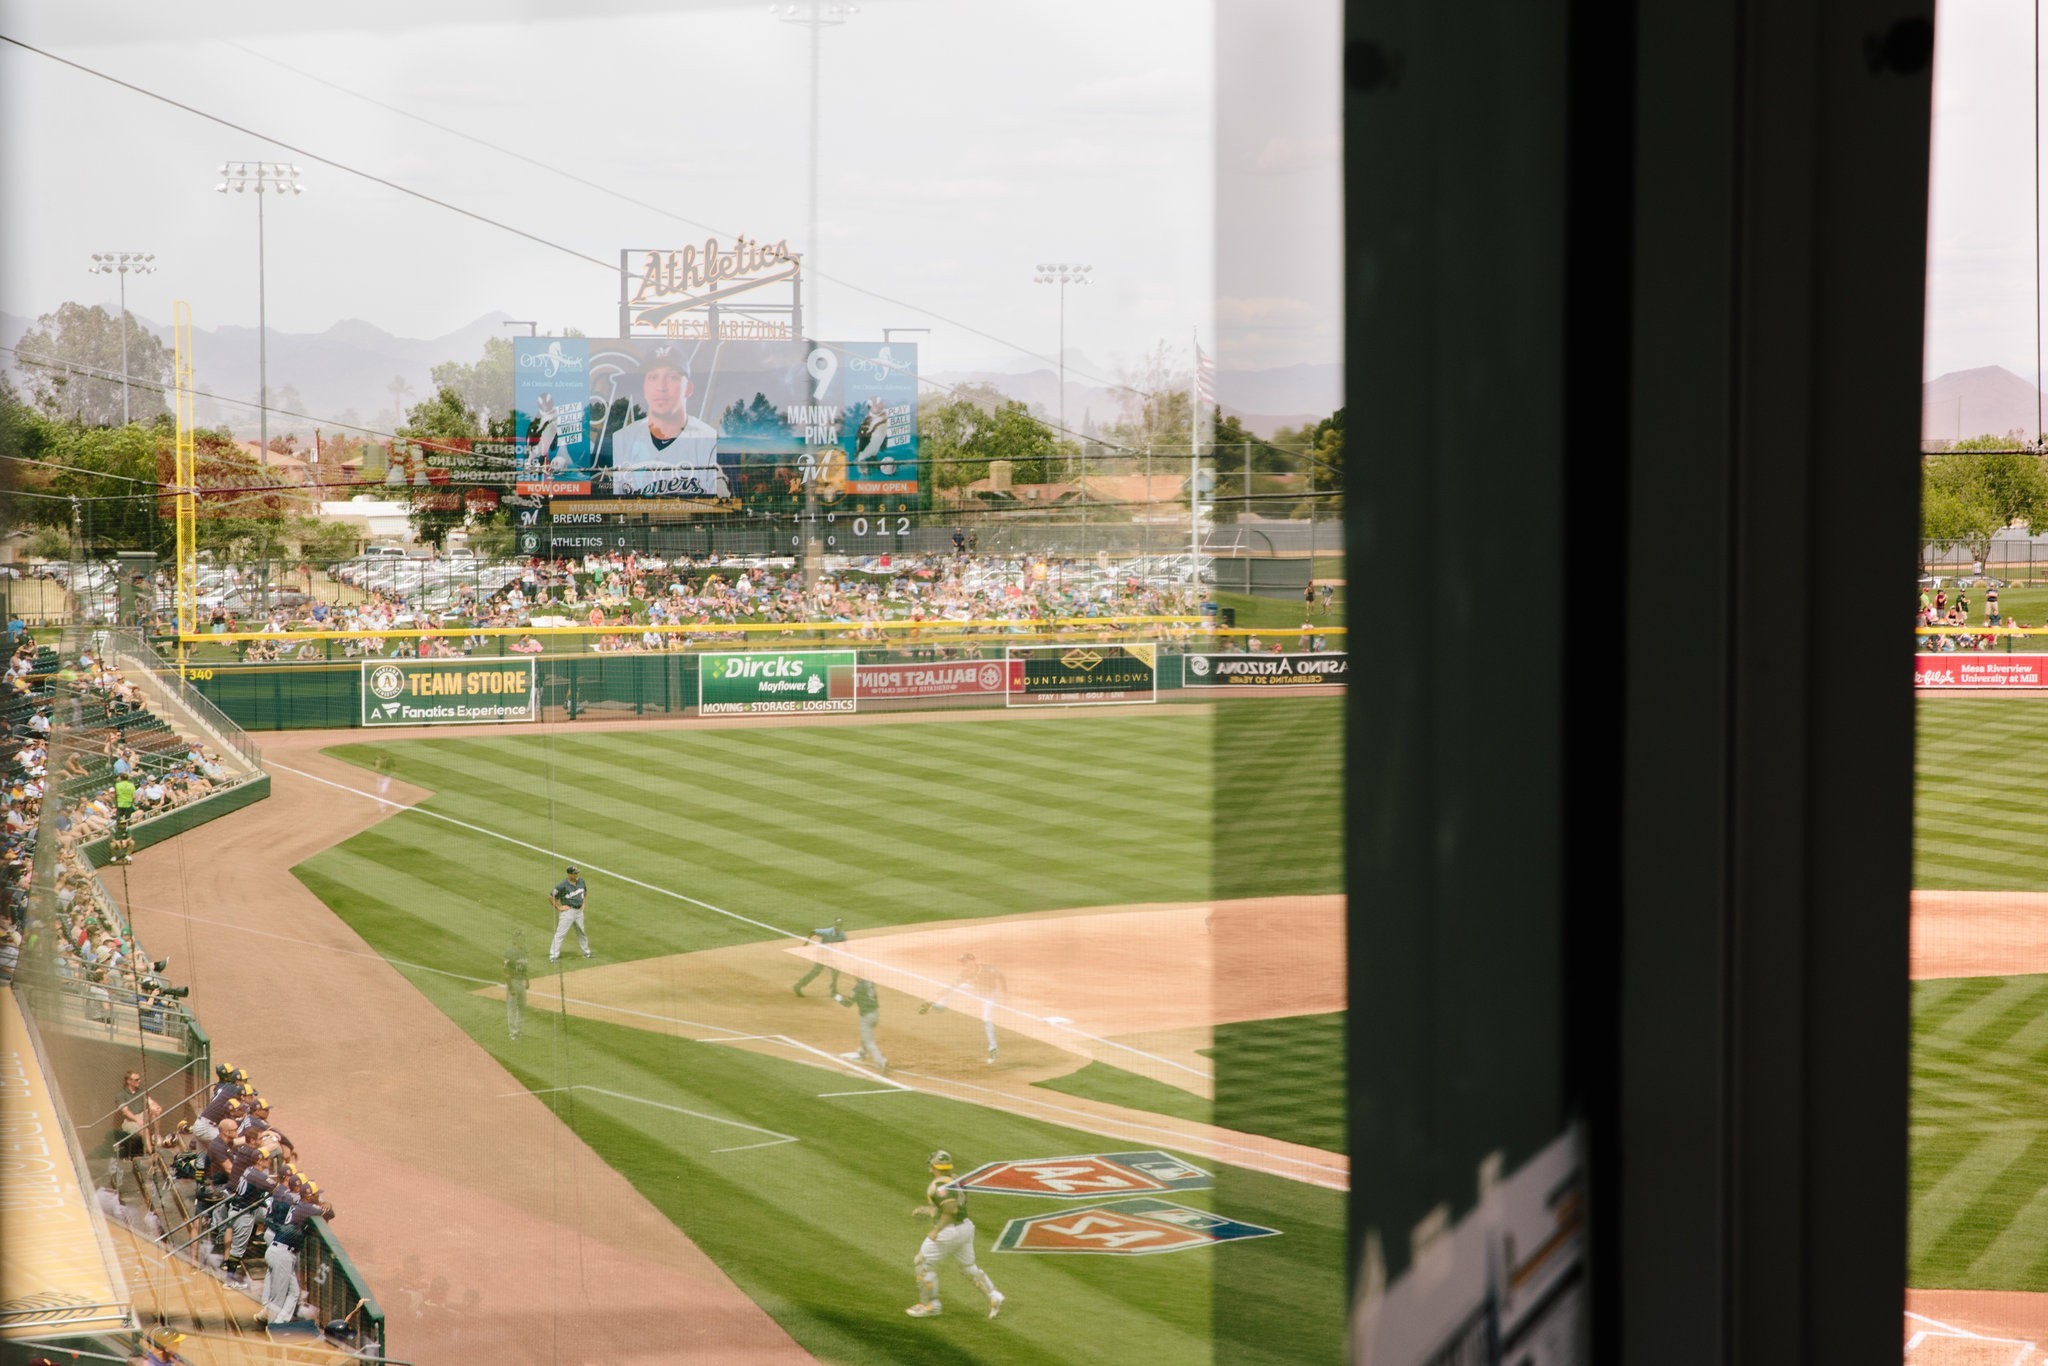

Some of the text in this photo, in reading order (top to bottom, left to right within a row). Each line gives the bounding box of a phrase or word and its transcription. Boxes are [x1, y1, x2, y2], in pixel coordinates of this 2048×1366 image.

[629, 234, 798, 305] Athletics
[667, 319, 787, 340] MESA ARIZONA
[807, 349, 838, 400] 9
[559, 403, 578, 412] PLAY
[888, 406, 908, 415] PLAY
[560, 414, 580, 423] BALL
[788, 405, 838, 424] MANNY
[890, 416, 909, 425] BALL
[561, 424, 581, 433] WITH
[891, 426, 909, 435] WITH
[565, 435, 579, 443] US!
[894, 436, 907, 445] US!
[527, 484, 580, 492] NOW OPEN
[856, 483, 908, 491] NOW OPEN
[553, 514, 835, 524] BREWERS 1 1 1 0
[853, 517, 910, 536] 0 1 2
[551, 536, 835, 547] ATHLETICS 0 0 1 0
[725, 656, 804, 678] Dircks
[1961, 664, 2033, 673] Mesa Riverview
[189, 669, 214, 680] 340
[1088, 673, 1149, 683] SHADOWS
[1961, 674, 2006, 684] University
[2020, 674, 2038, 682] Mill
[409, 671, 526, 696] TEAM STORE
[758, 681, 806, 693] Mayflower
[703, 700, 853, 713] MOVING STORAGE LOGISTICS
[370, 705, 526, 719] A Fanatics Experience
